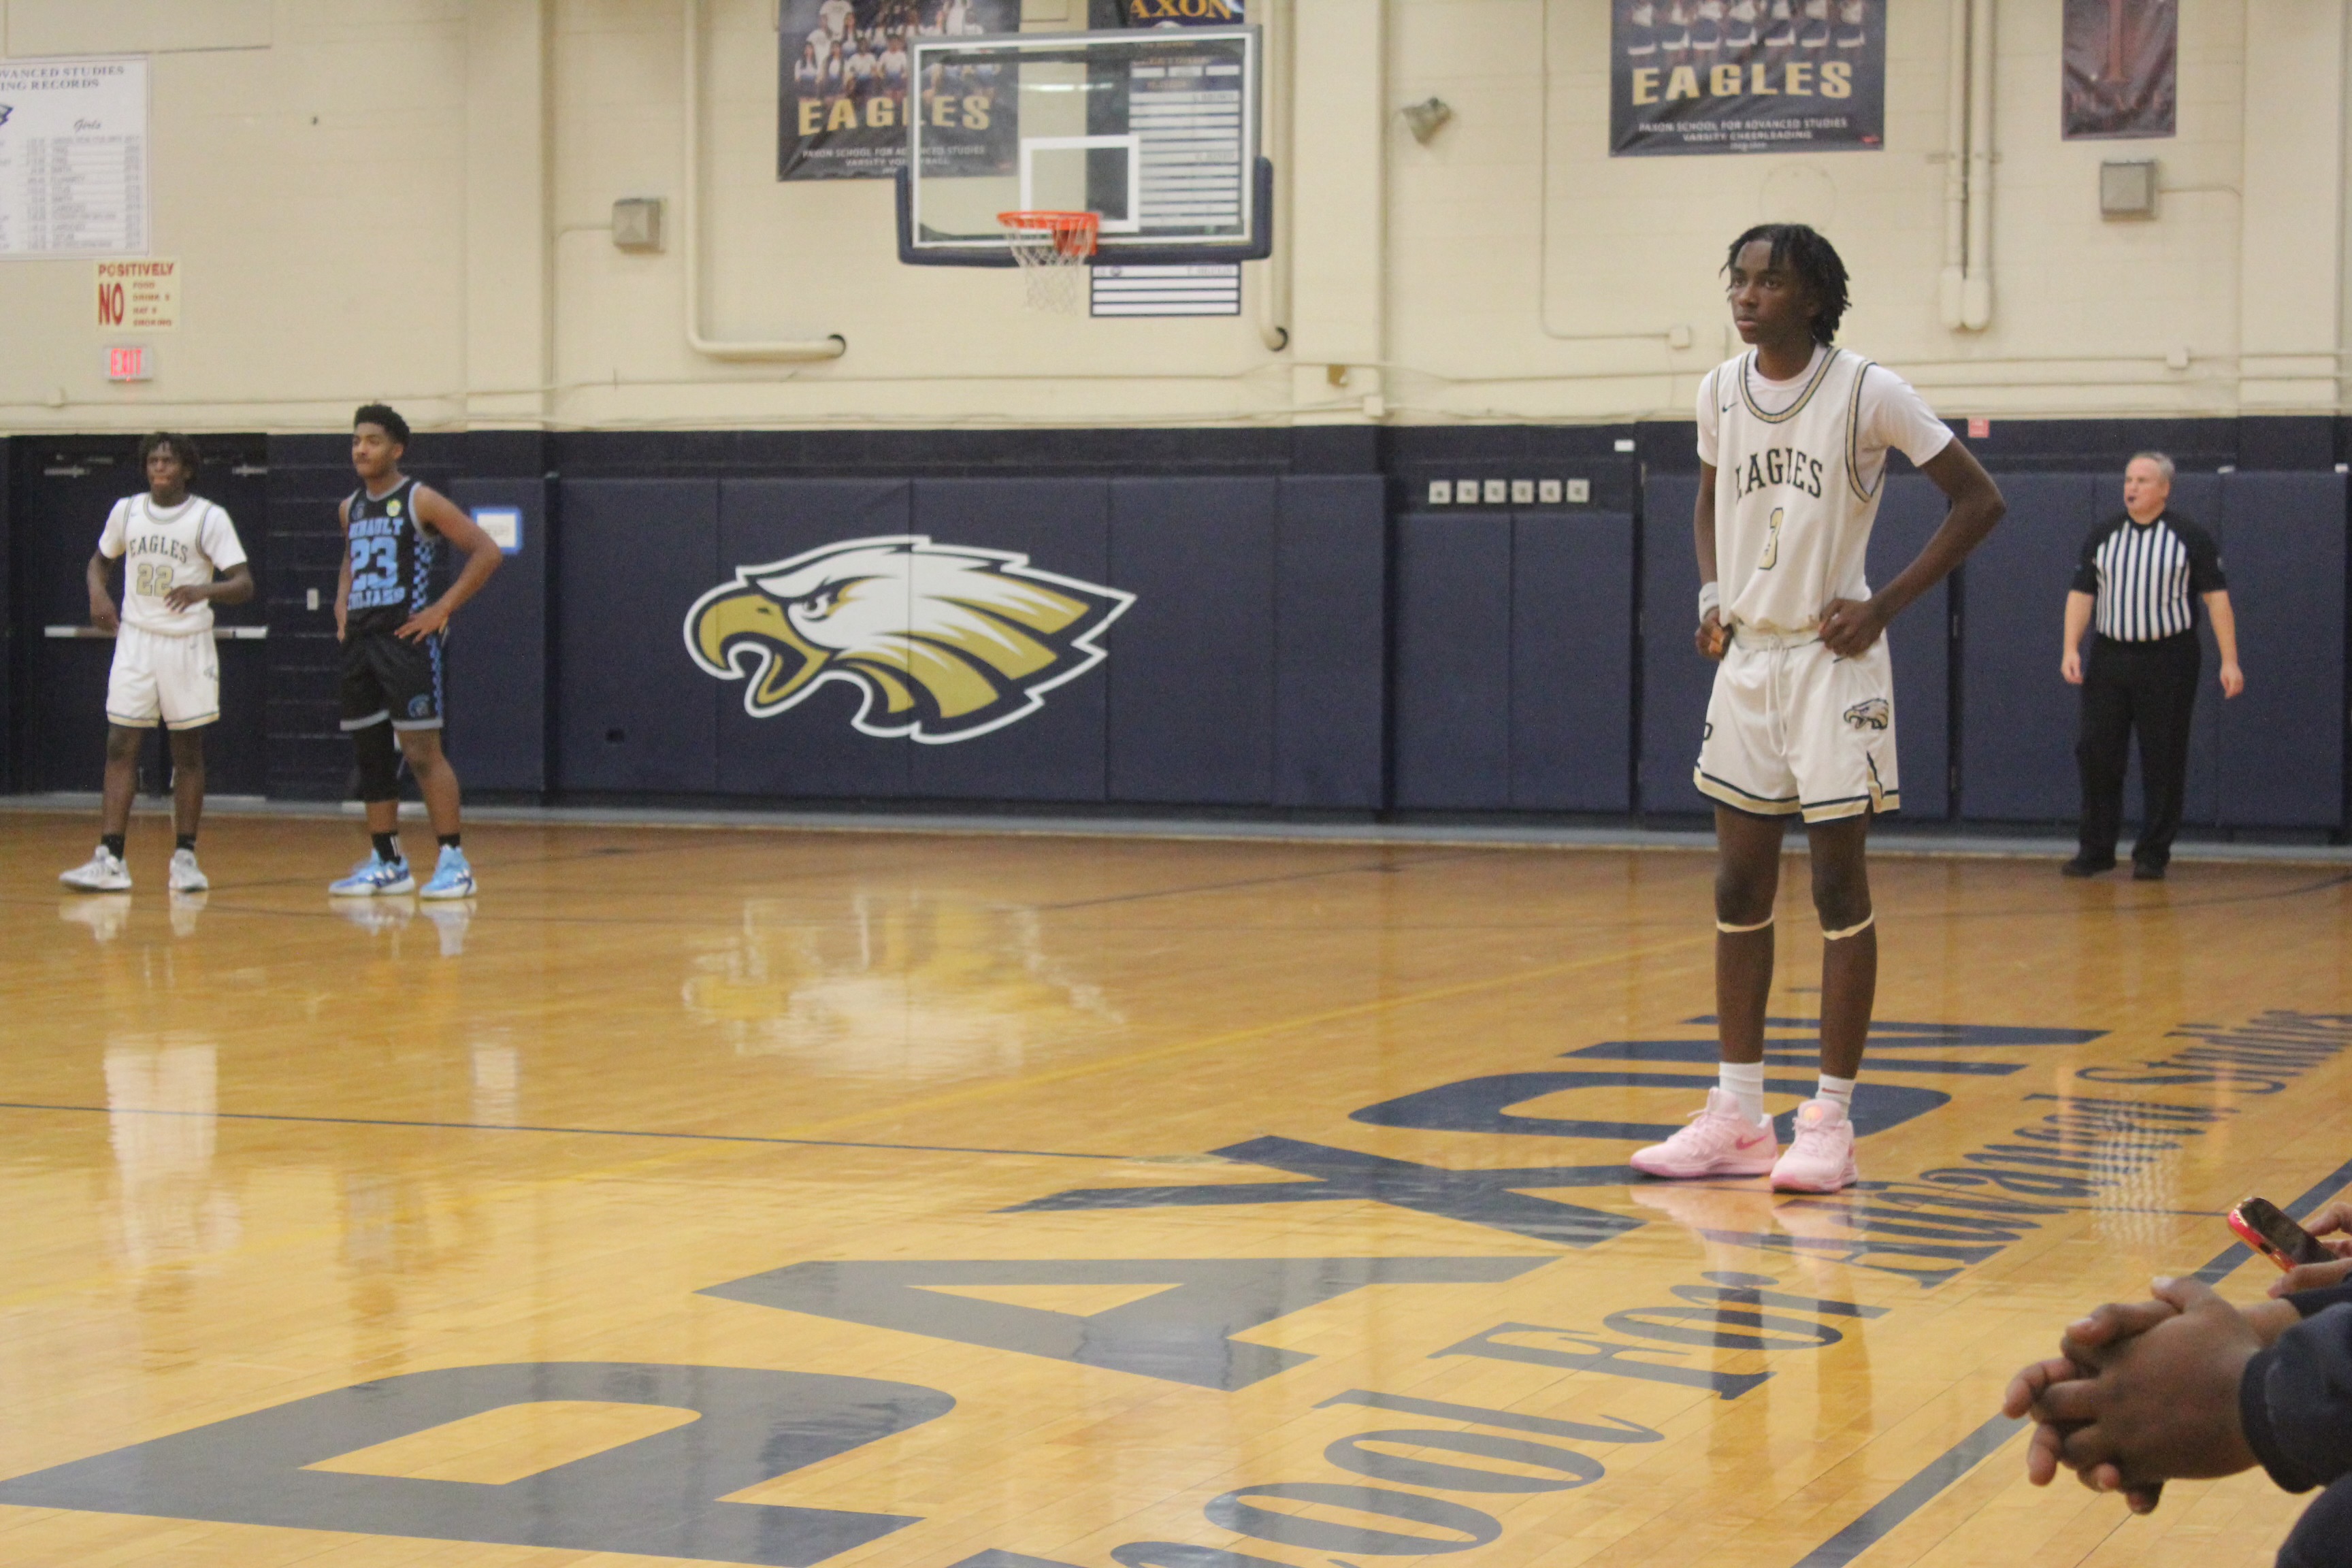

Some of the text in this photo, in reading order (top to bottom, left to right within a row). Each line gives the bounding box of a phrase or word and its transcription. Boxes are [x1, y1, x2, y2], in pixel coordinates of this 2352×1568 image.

[0, 66, 125, 79] VANCED STUDIES
[1633, 61, 1852, 105] EAGLES
[31, 79, 99, 91] RECORDS
[1639, 117, 1848, 133] PAXON SCHOOL FOR ADVANCED STUDIES
[1682, 130, 1814, 142] VARSITY CHEERLEADING
[802, 144, 986, 159] PAXON SCHOOL FOR ADNCED STUDIES
[845, 157, 950, 167] VARSITY VOLYBALL
[98, 261, 174, 277] POSITIVELY
[133, 282, 155, 290] FOOD
[98, 282, 125, 326] NO
[111, 348, 142, 376] EXIT
[130, 535, 189, 564] EAGLES
[350, 536, 398, 592] 23
[136, 563, 174, 597] 22
[1426, 1271, 1892, 1401] For
[1695, 1092, 2242, 1289] Advanced
[0, 1015, 2115, 1568] PAXON
